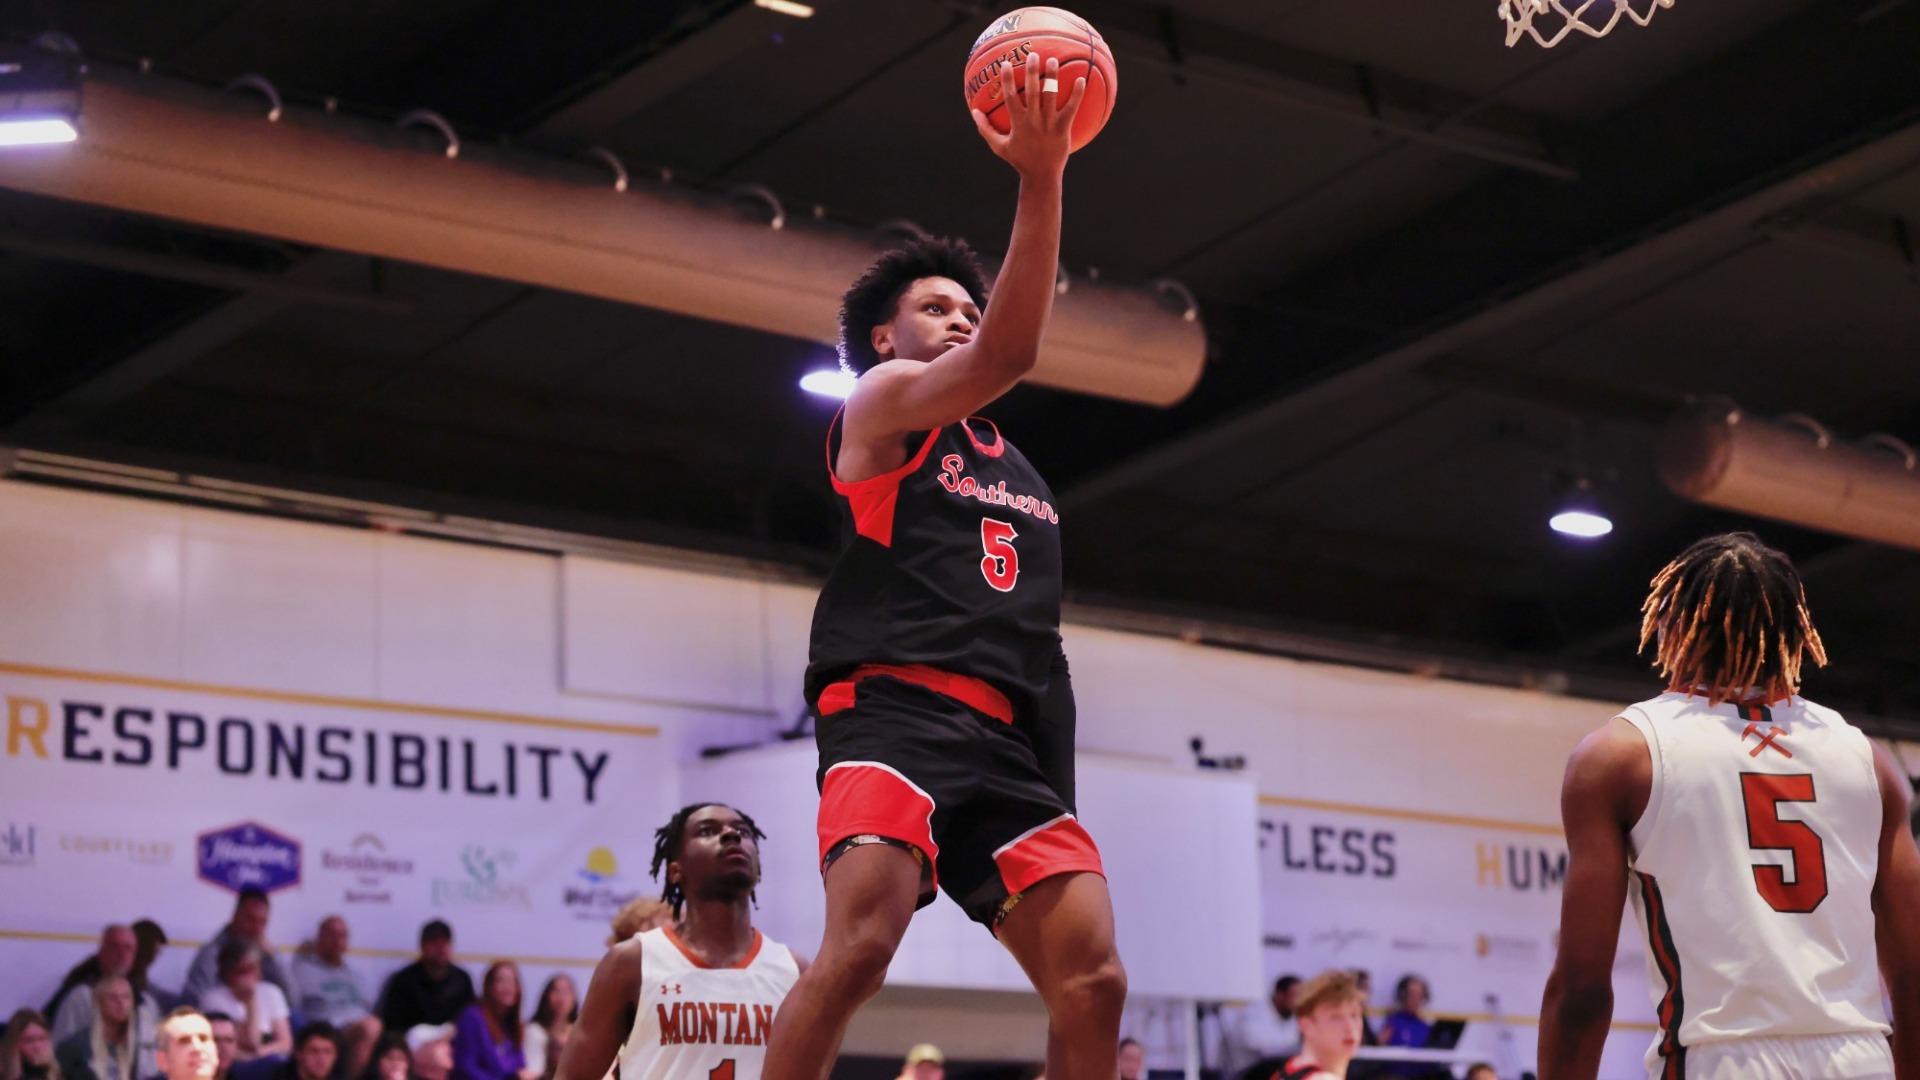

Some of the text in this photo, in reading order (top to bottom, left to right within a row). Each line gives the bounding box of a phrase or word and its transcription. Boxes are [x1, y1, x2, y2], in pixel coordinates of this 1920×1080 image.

[937, 454, 1059, 524] Southern
[981, 517, 1020, 592] 5
[6, 697, 609, 804] RESPONSIBILITY
[1739, 771, 1828, 914] 5
[656, 1001, 773, 1047] MONTAN
